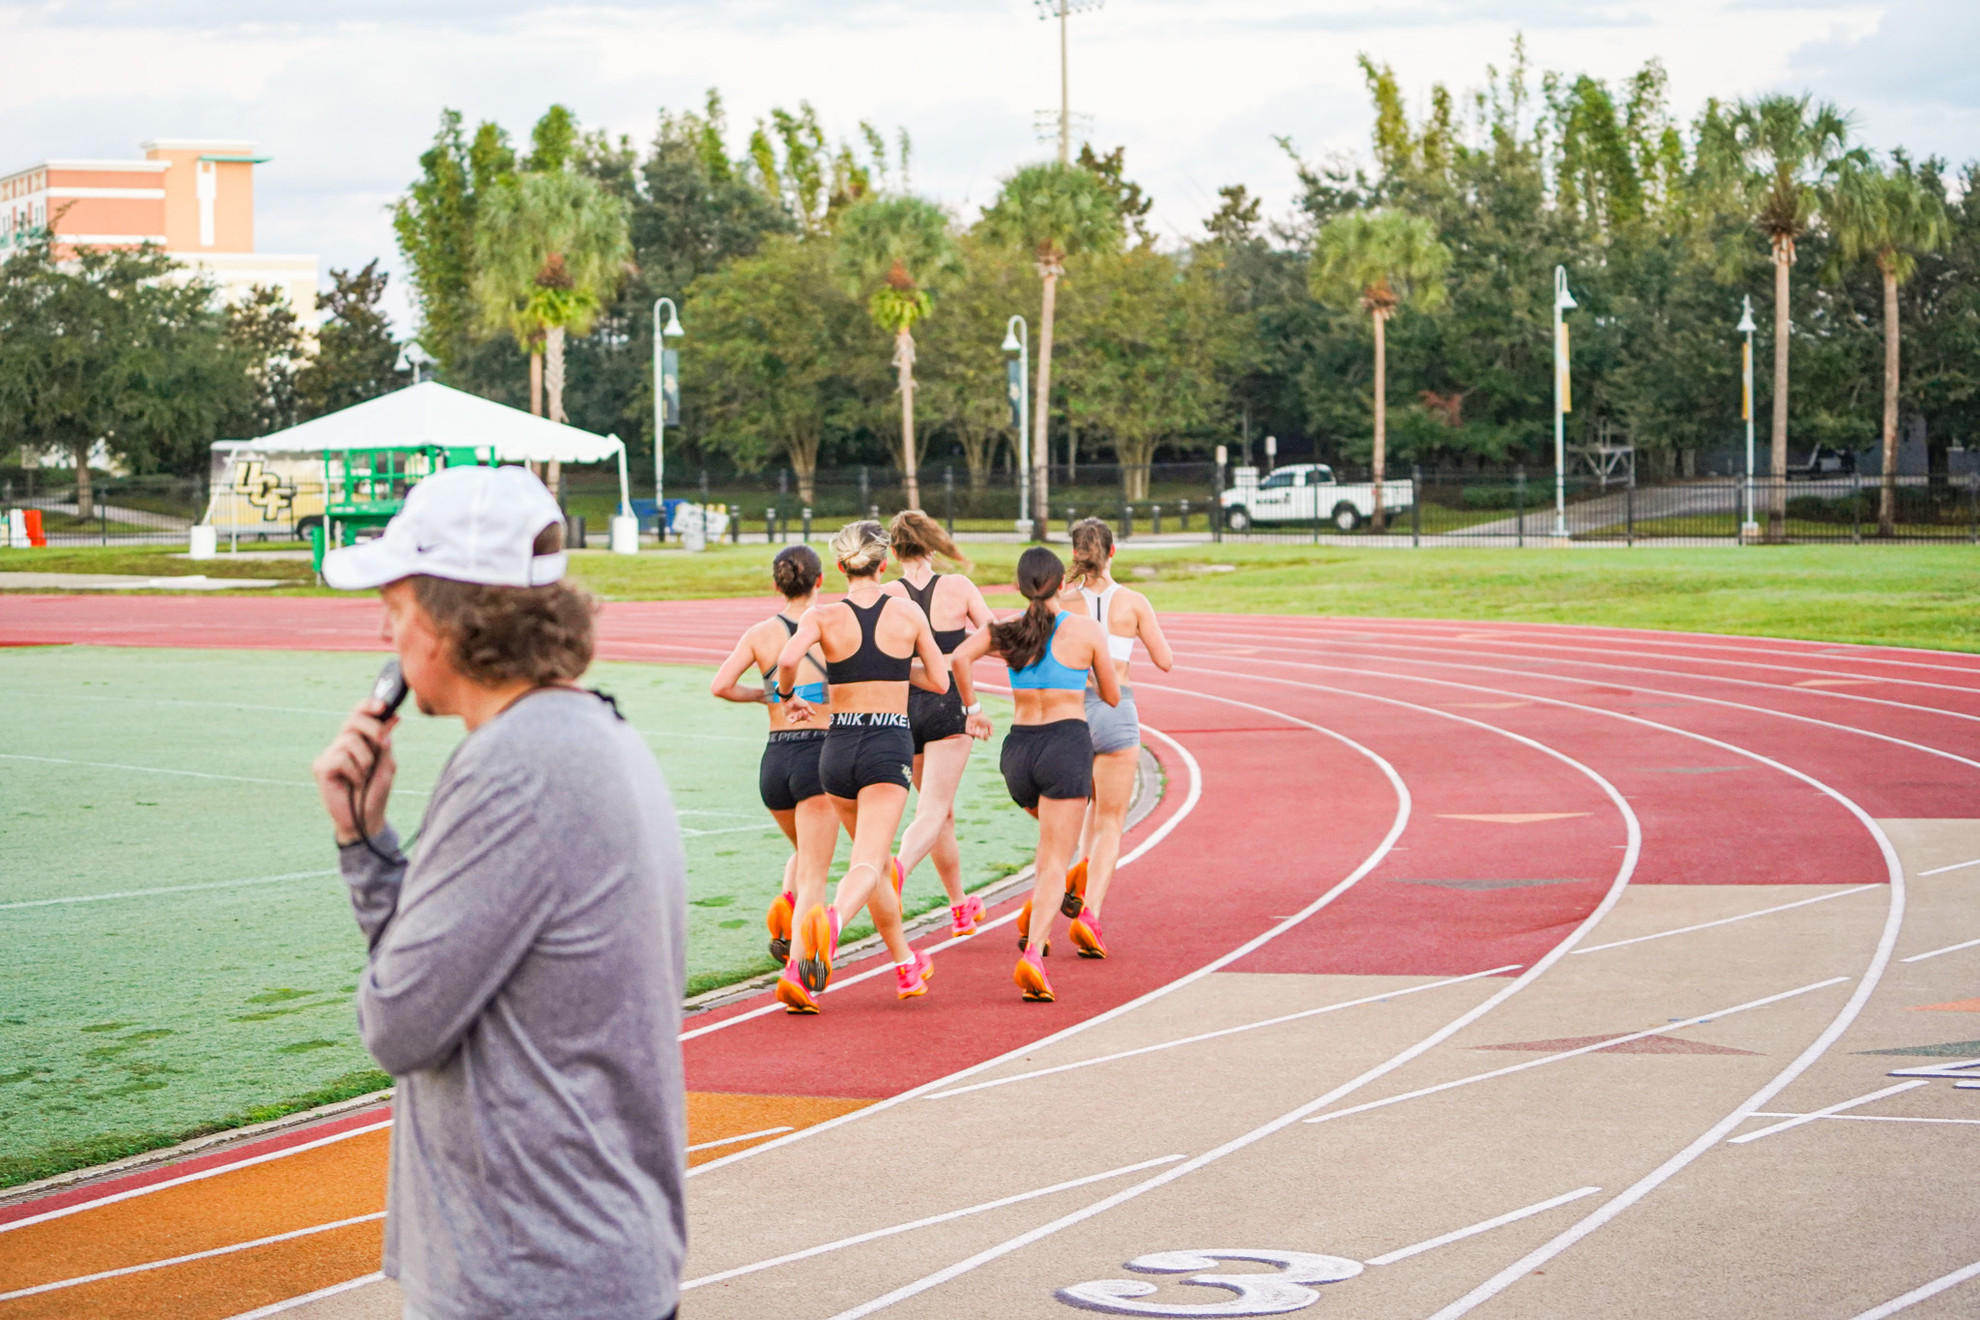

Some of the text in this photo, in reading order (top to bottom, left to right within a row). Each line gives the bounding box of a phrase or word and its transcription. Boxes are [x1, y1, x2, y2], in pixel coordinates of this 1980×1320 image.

[232, 461, 296, 521] UCF
[836, 712, 865, 726] NIK
[869, 712, 908, 727] NIKE
[1053, 1248, 1365, 1319] 3
